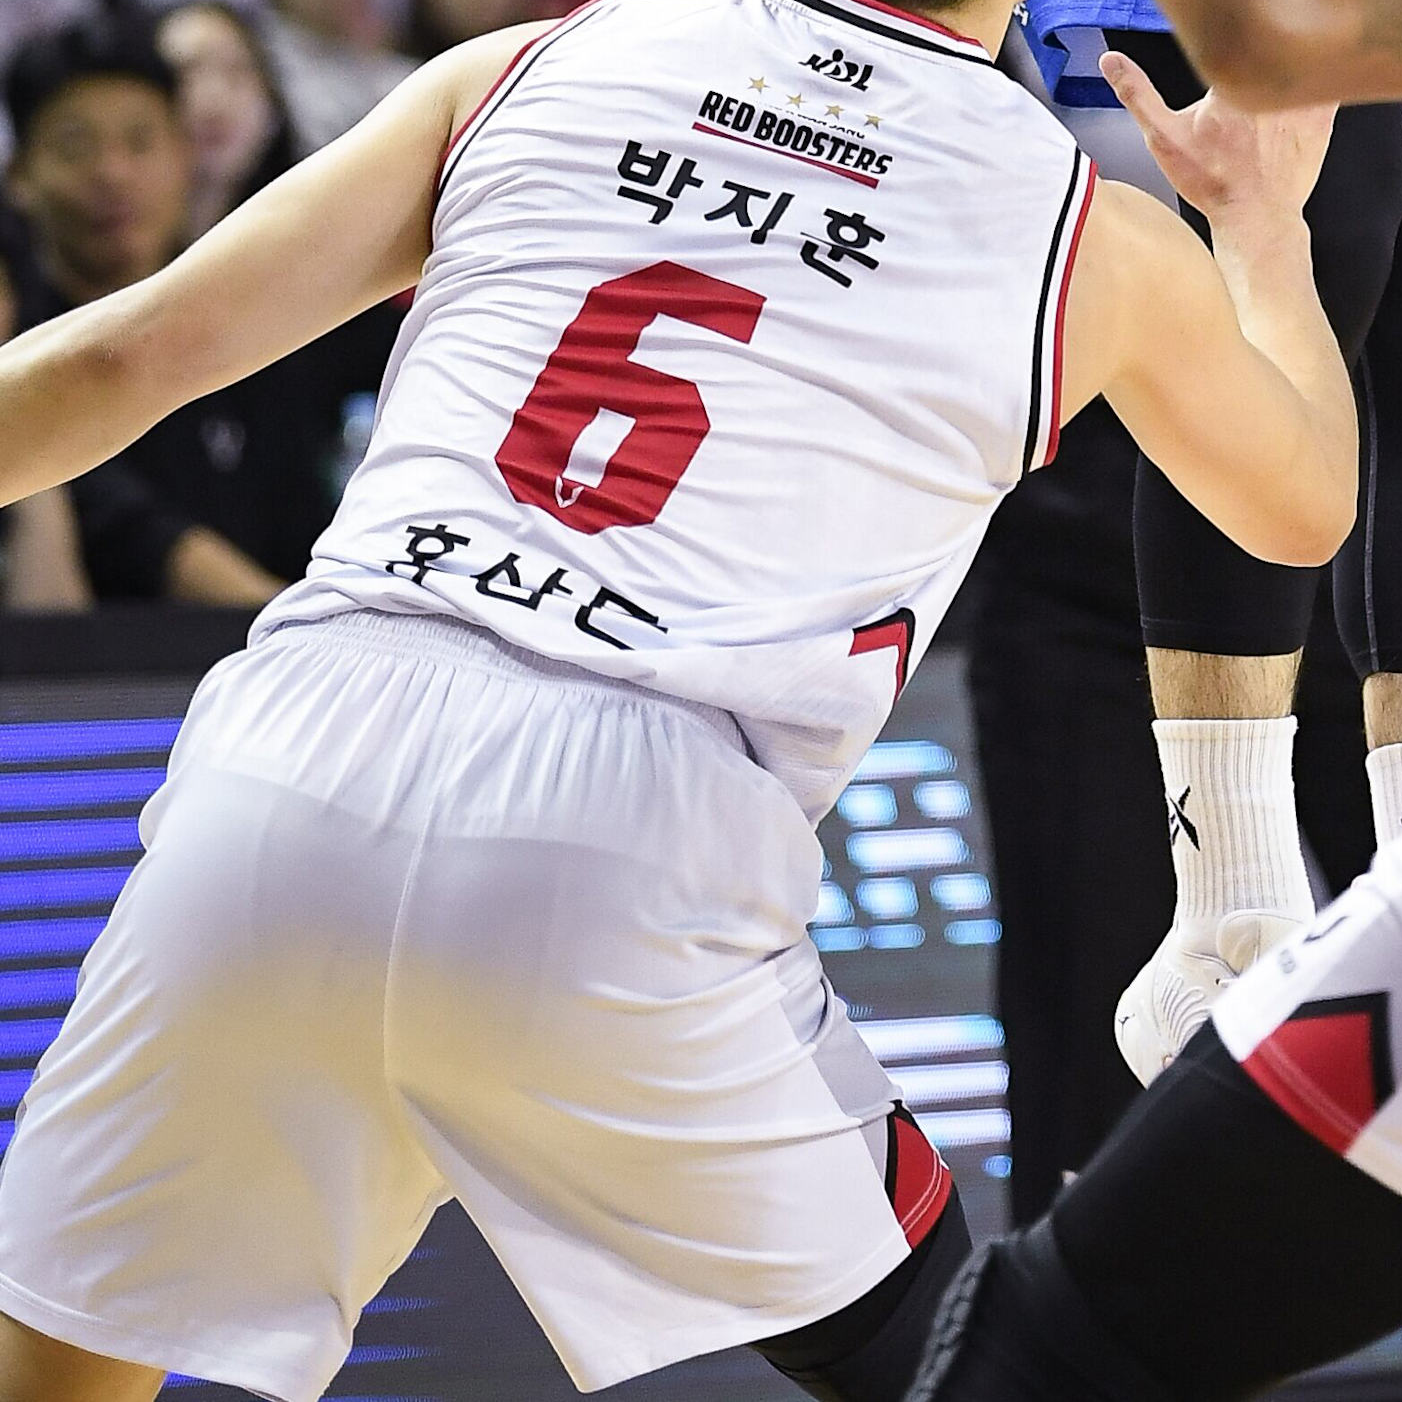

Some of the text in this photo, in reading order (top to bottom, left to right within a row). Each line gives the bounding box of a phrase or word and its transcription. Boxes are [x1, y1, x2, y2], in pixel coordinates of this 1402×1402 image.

[698, 90, 756, 132] RED
[753, 111, 893, 175] BOOSTERS
[617, 140, 886, 289] 박지훈
[495, 260, 767, 535] 6
